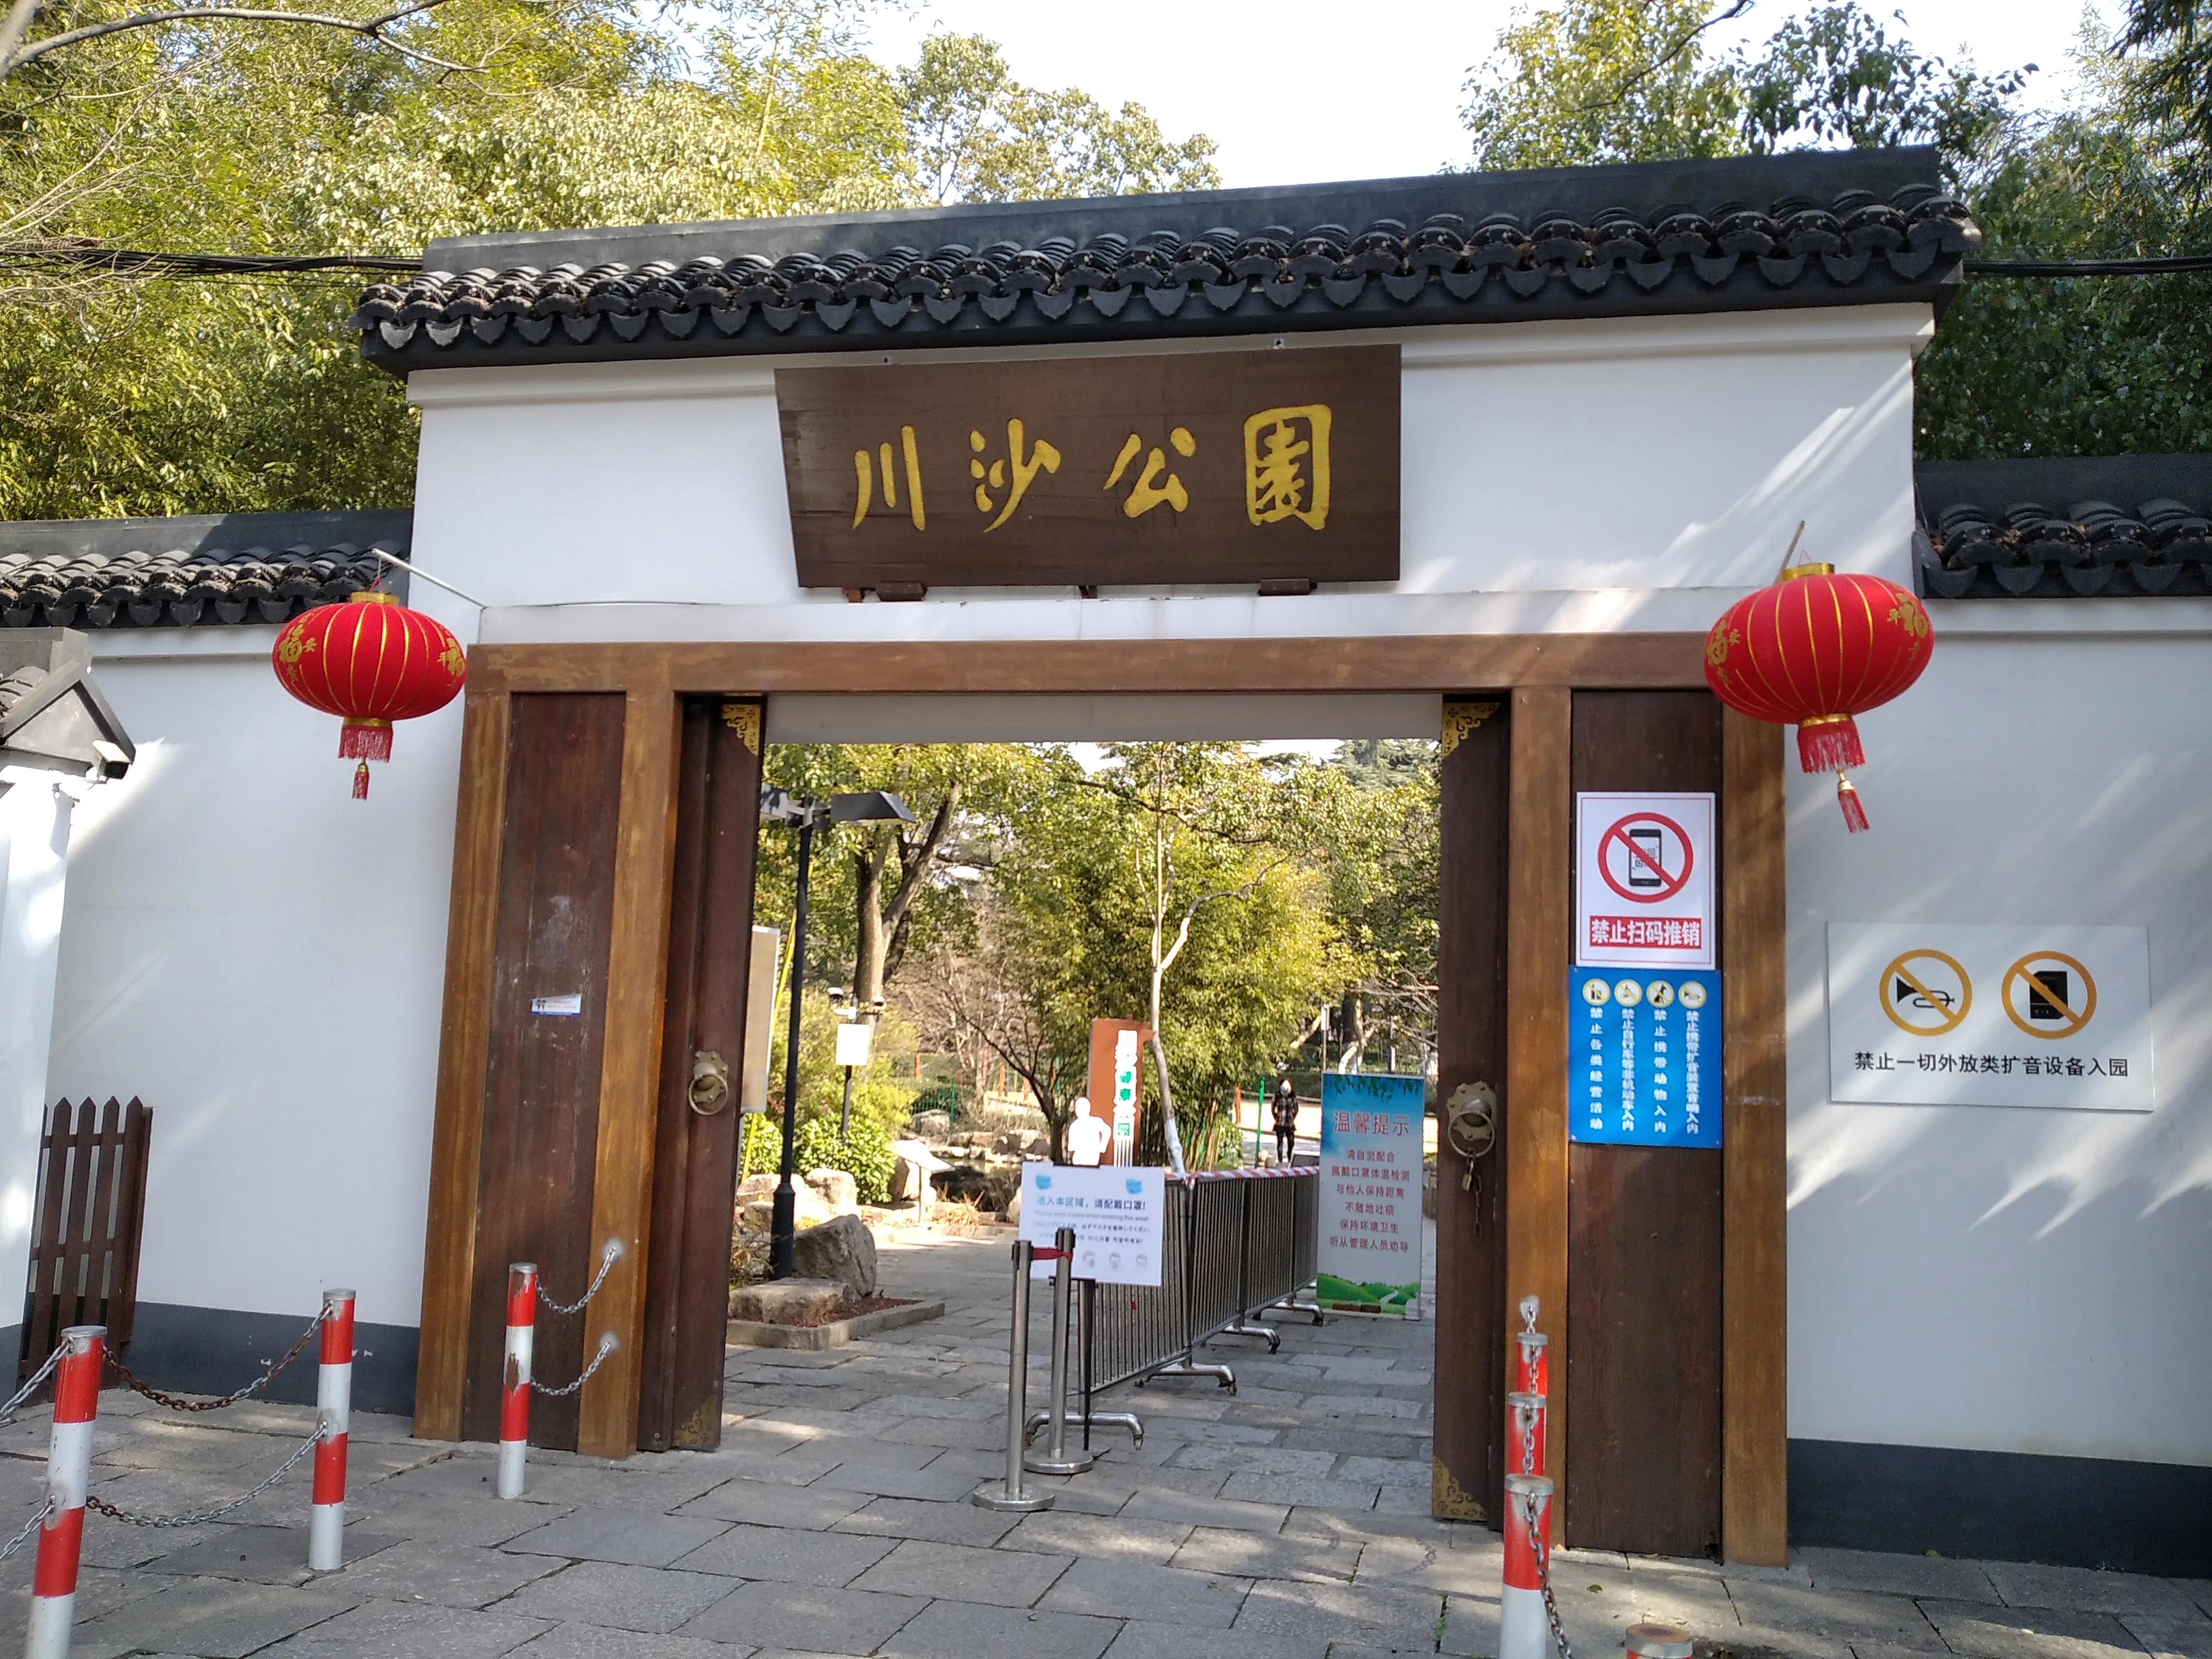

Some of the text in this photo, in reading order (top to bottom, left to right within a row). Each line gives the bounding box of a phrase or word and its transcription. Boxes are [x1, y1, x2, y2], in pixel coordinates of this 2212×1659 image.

[1591, 918, 1700, 947] 禁止扫码推销
[1654, 1009, 1668, 1133] 禁止携带动物入内
[1854, 1051, 2129, 1077] 禁止一切外放类扩音设备入园
[1334, 1110, 1410, 1136] 温馨提示
[1347, 1149, 1395, 1162] 请自觉配合
[1331, 1165, 1410, 1182] 佩戴口罩体温检测
[1336, 1183, 1404, 1198] 与他人保持距离
[1345, 1201, 1395, 1215] 不随地吐痰
[1340, 1219, 1398, 1234] 保持环境卫生
[1330, 1236, 1409, 1252] 听从管理人员劝导
